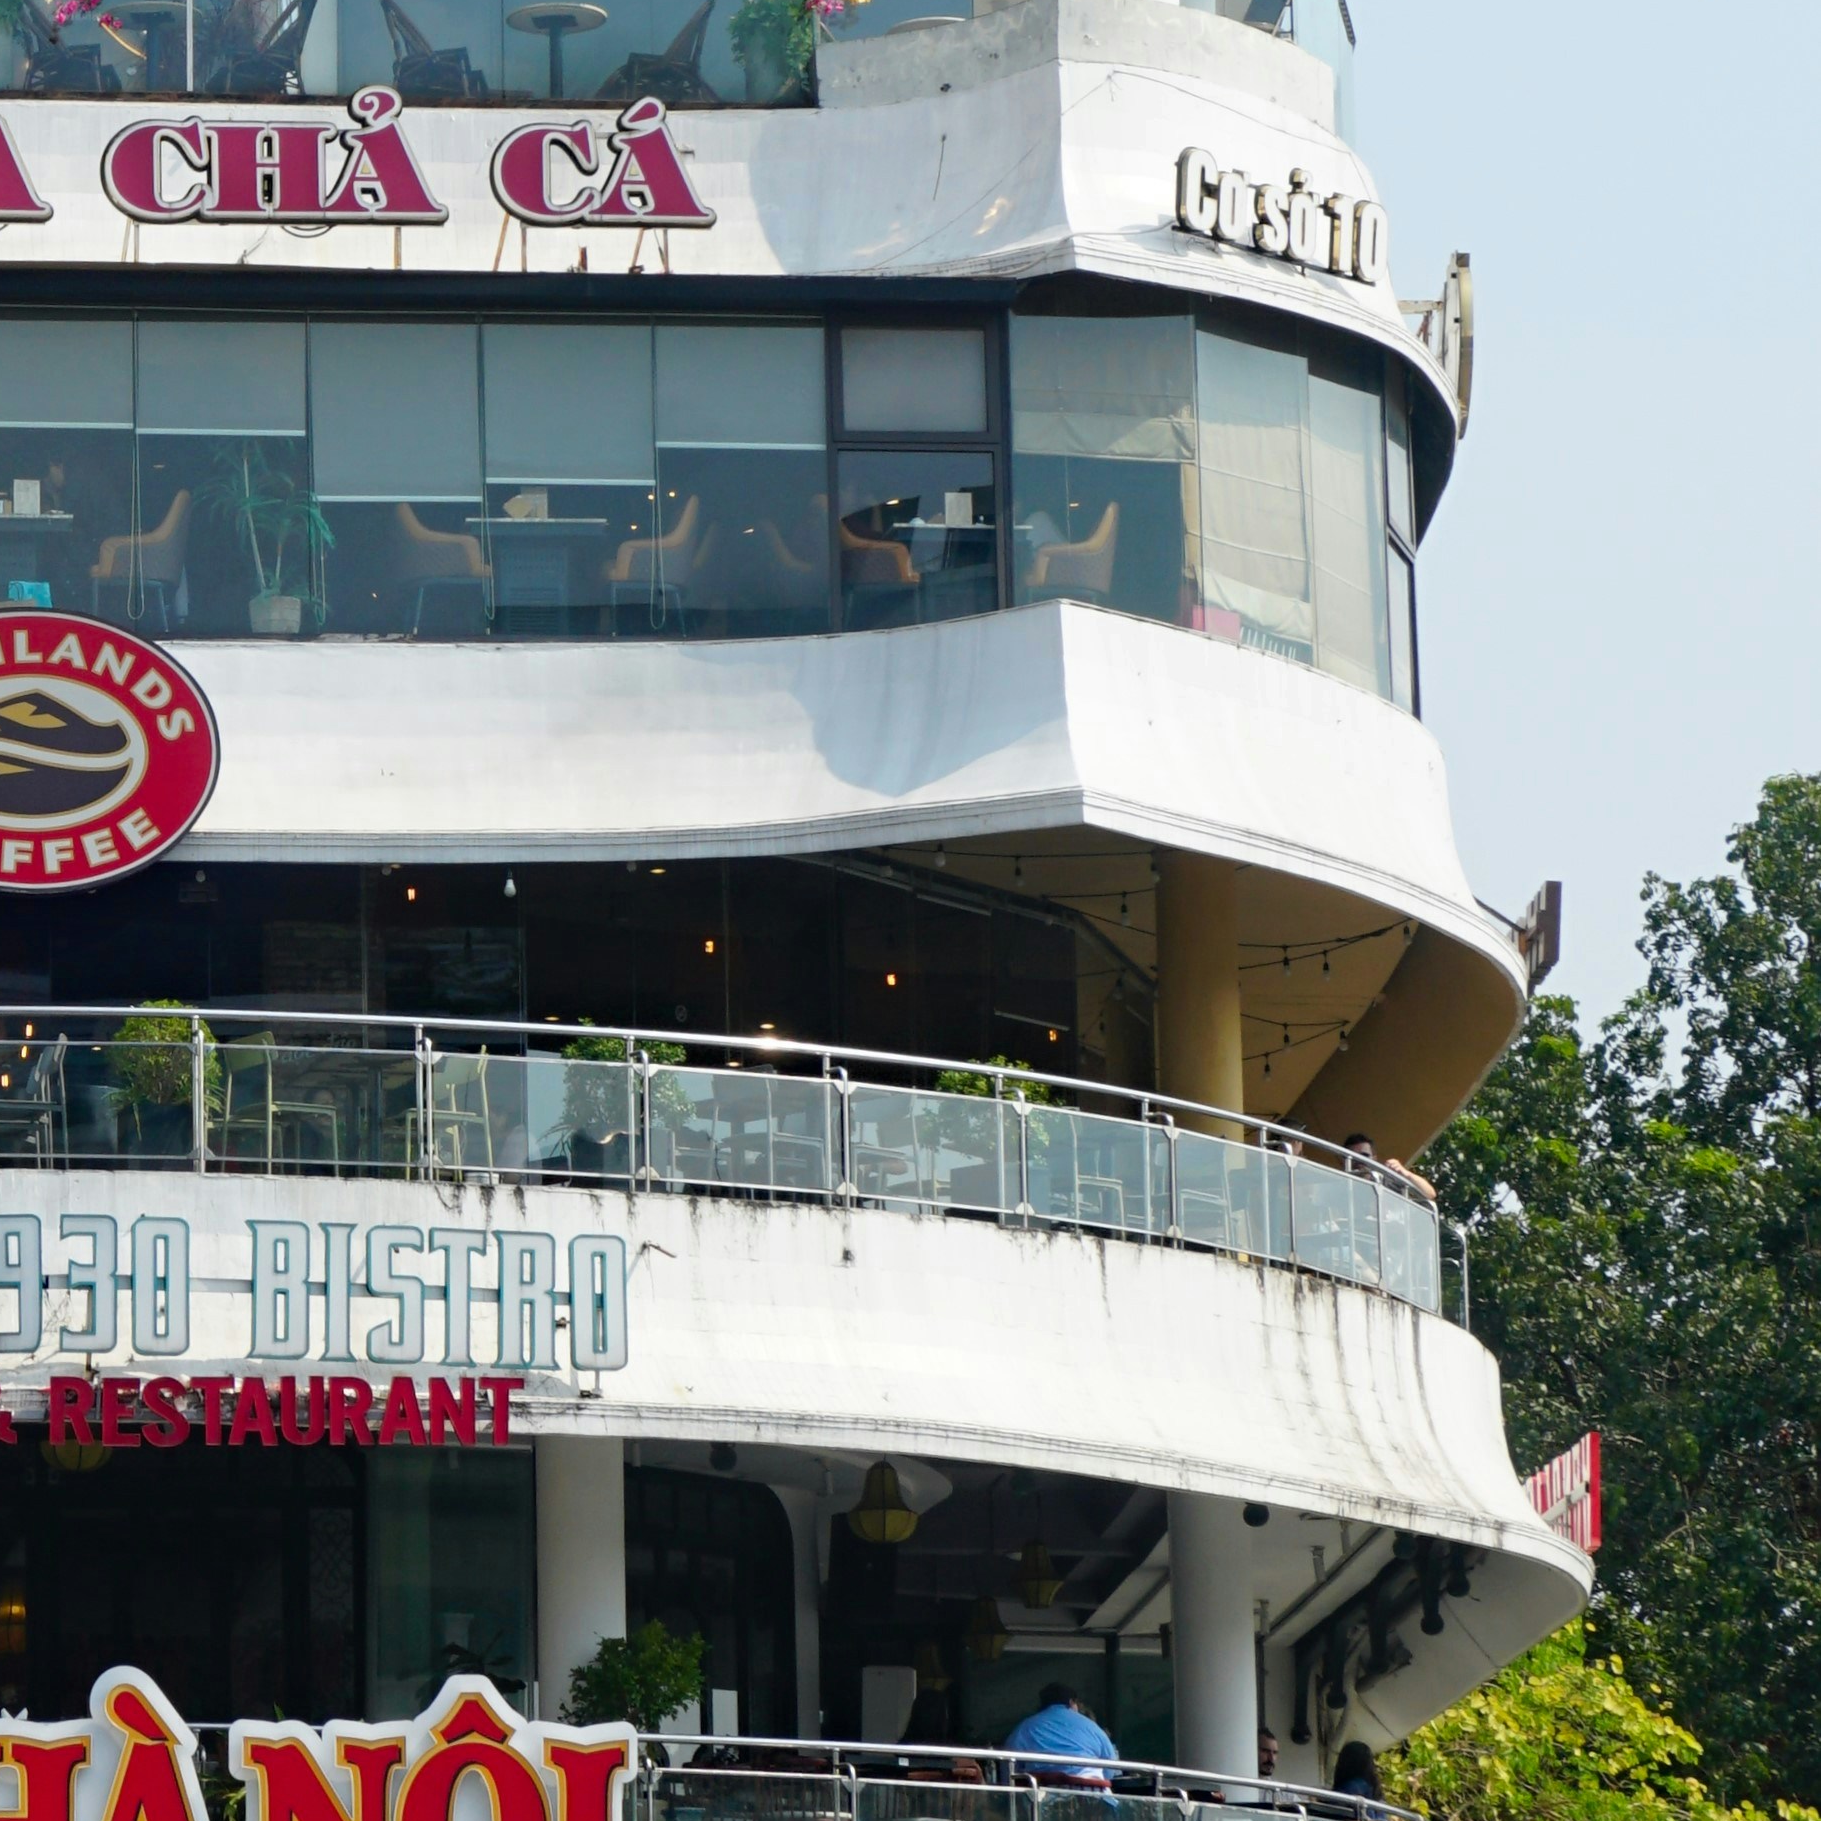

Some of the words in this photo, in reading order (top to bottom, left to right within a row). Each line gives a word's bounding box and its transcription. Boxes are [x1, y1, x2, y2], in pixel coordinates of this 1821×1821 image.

[99, 86, 450, 227] CHẢ
[489, 95, 718, 230] CÁ
[1175, 145, 1251, 241] Cơ
[1253, 167, 1319, 261] sở
[1323, 192, 1389, 283] 10
[246, 1218, 629, 1372] BISTRO
[48, 1374, 525, 1448] RESTAURANT
